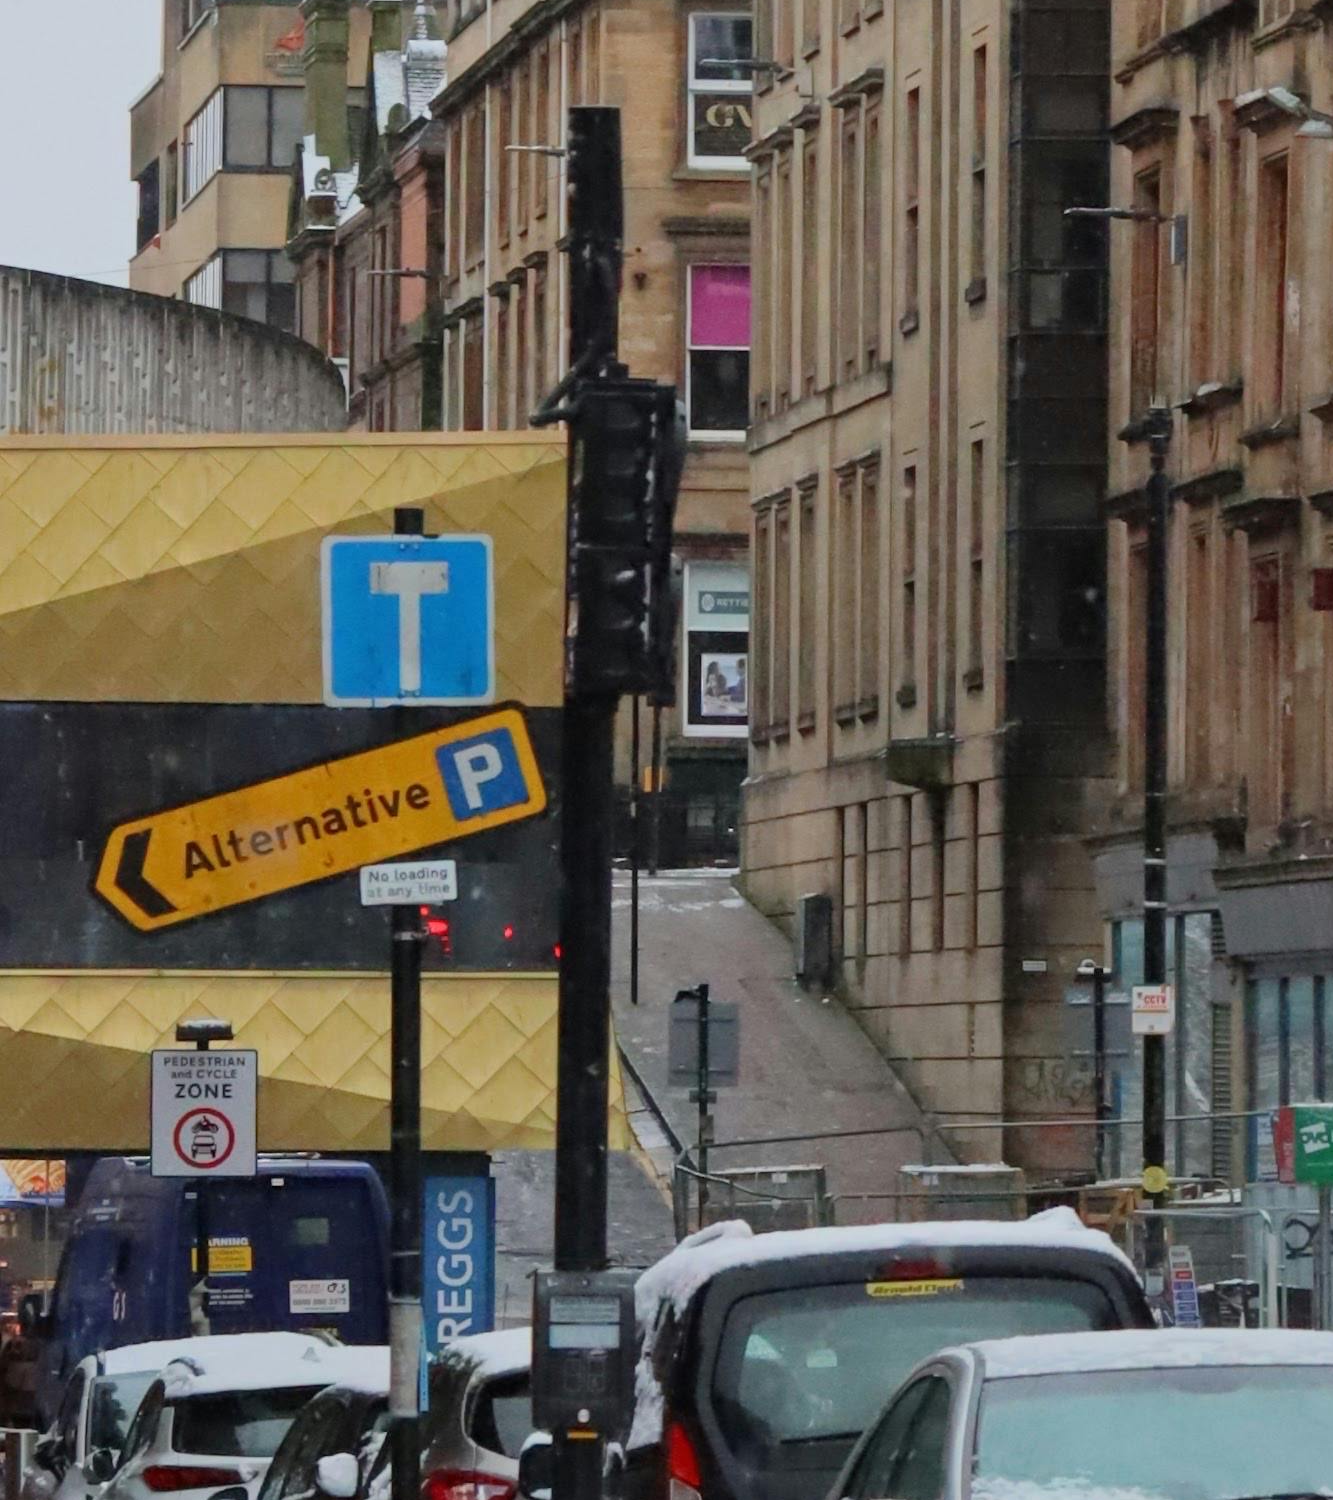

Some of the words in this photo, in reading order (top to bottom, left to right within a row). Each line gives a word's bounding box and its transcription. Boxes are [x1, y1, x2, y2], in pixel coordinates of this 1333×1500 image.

[184, 782, 430, 879] Alternative
[453, 743, 503, 810] P
[368, 871, 389, 883] No
[394, 867, 448, 881] loading
[388, 886, 412, 898] any
[418, 883, 450, 895] time
[163, 1056, 246, 1067] PEDESTRIAN
[171, 1069, 192, 1079] and
[196, 1069, 238, 1079] CYCLE
[174, 1083, 234, 1099] ZONE
[194, 1236, 249, 1247] RNING
[437, 1189, 474, 1345] REGGS
